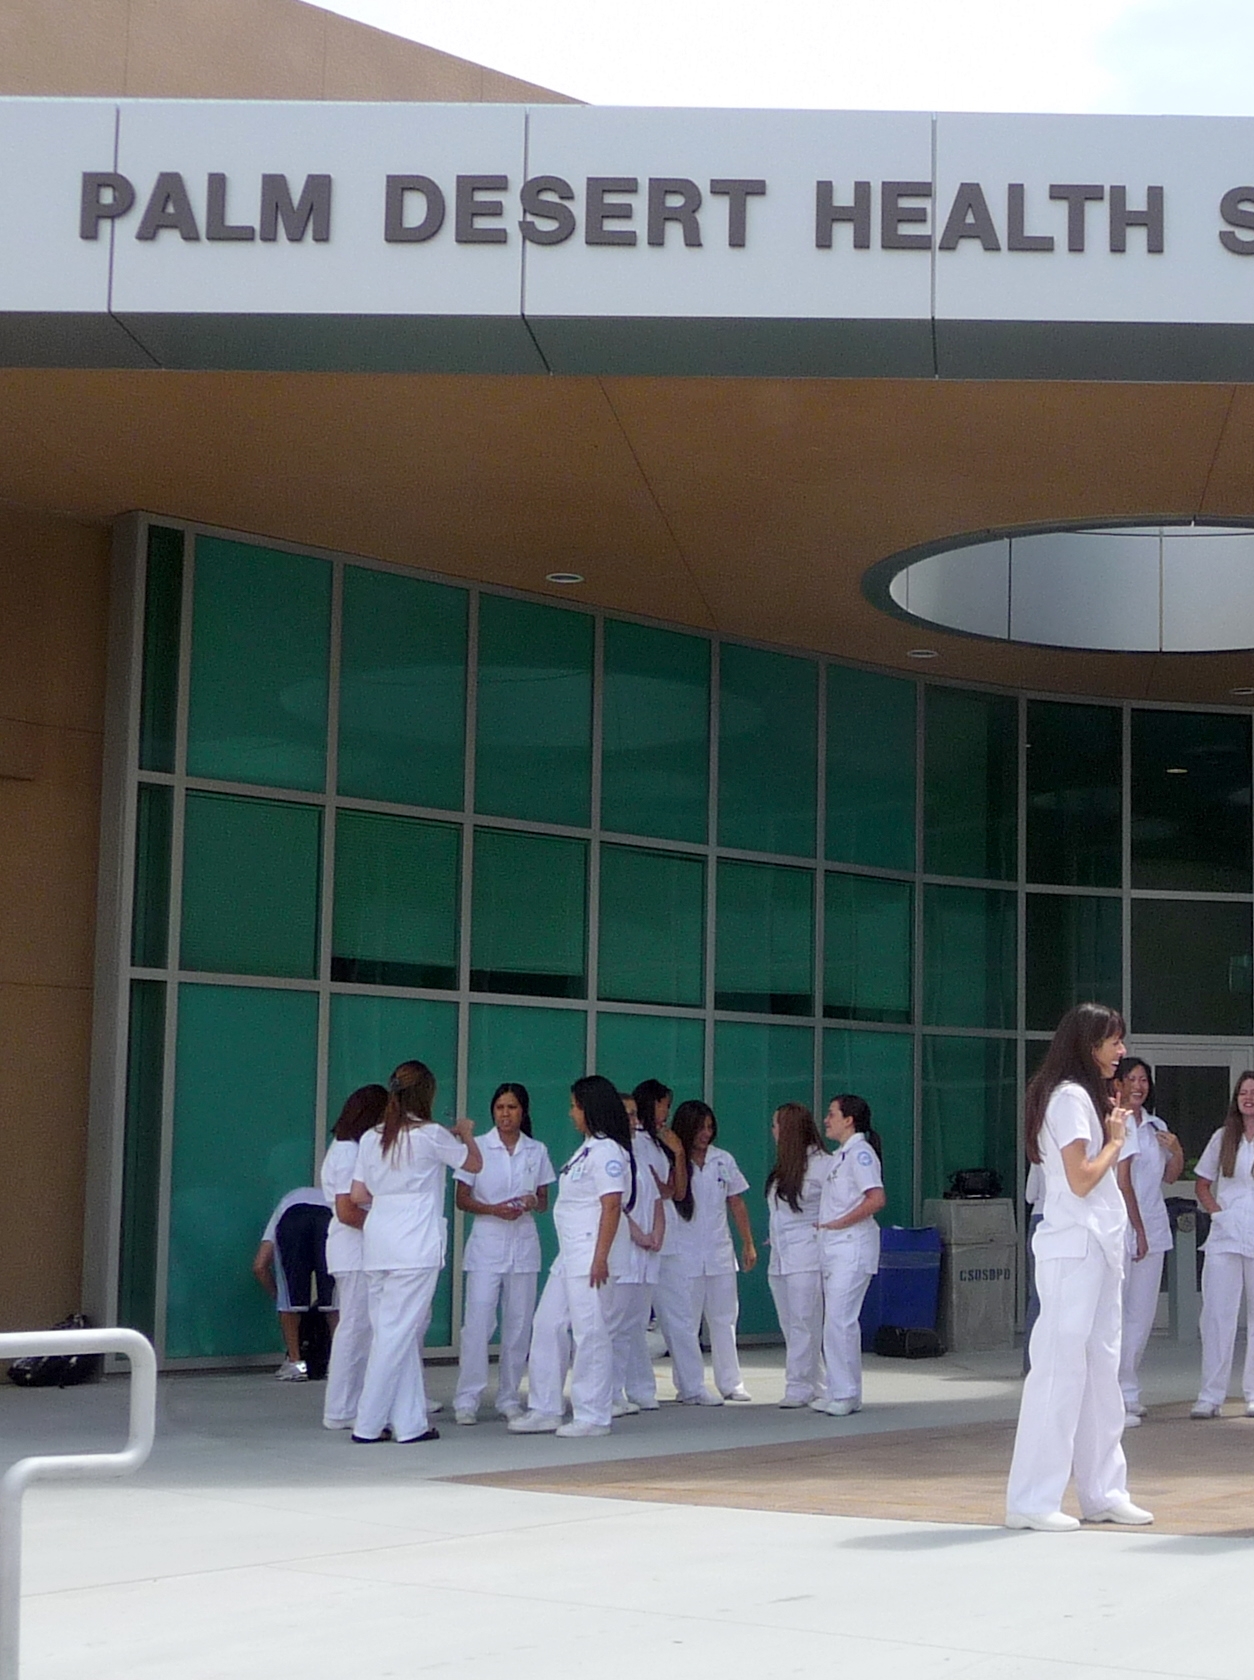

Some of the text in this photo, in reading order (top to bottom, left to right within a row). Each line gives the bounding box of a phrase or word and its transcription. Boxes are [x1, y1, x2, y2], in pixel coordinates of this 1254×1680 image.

[79, 168, 333, 244] PALM
[384, 174, 767, 249] DESERT
[815, 180, 1165, 255] HEALTH
